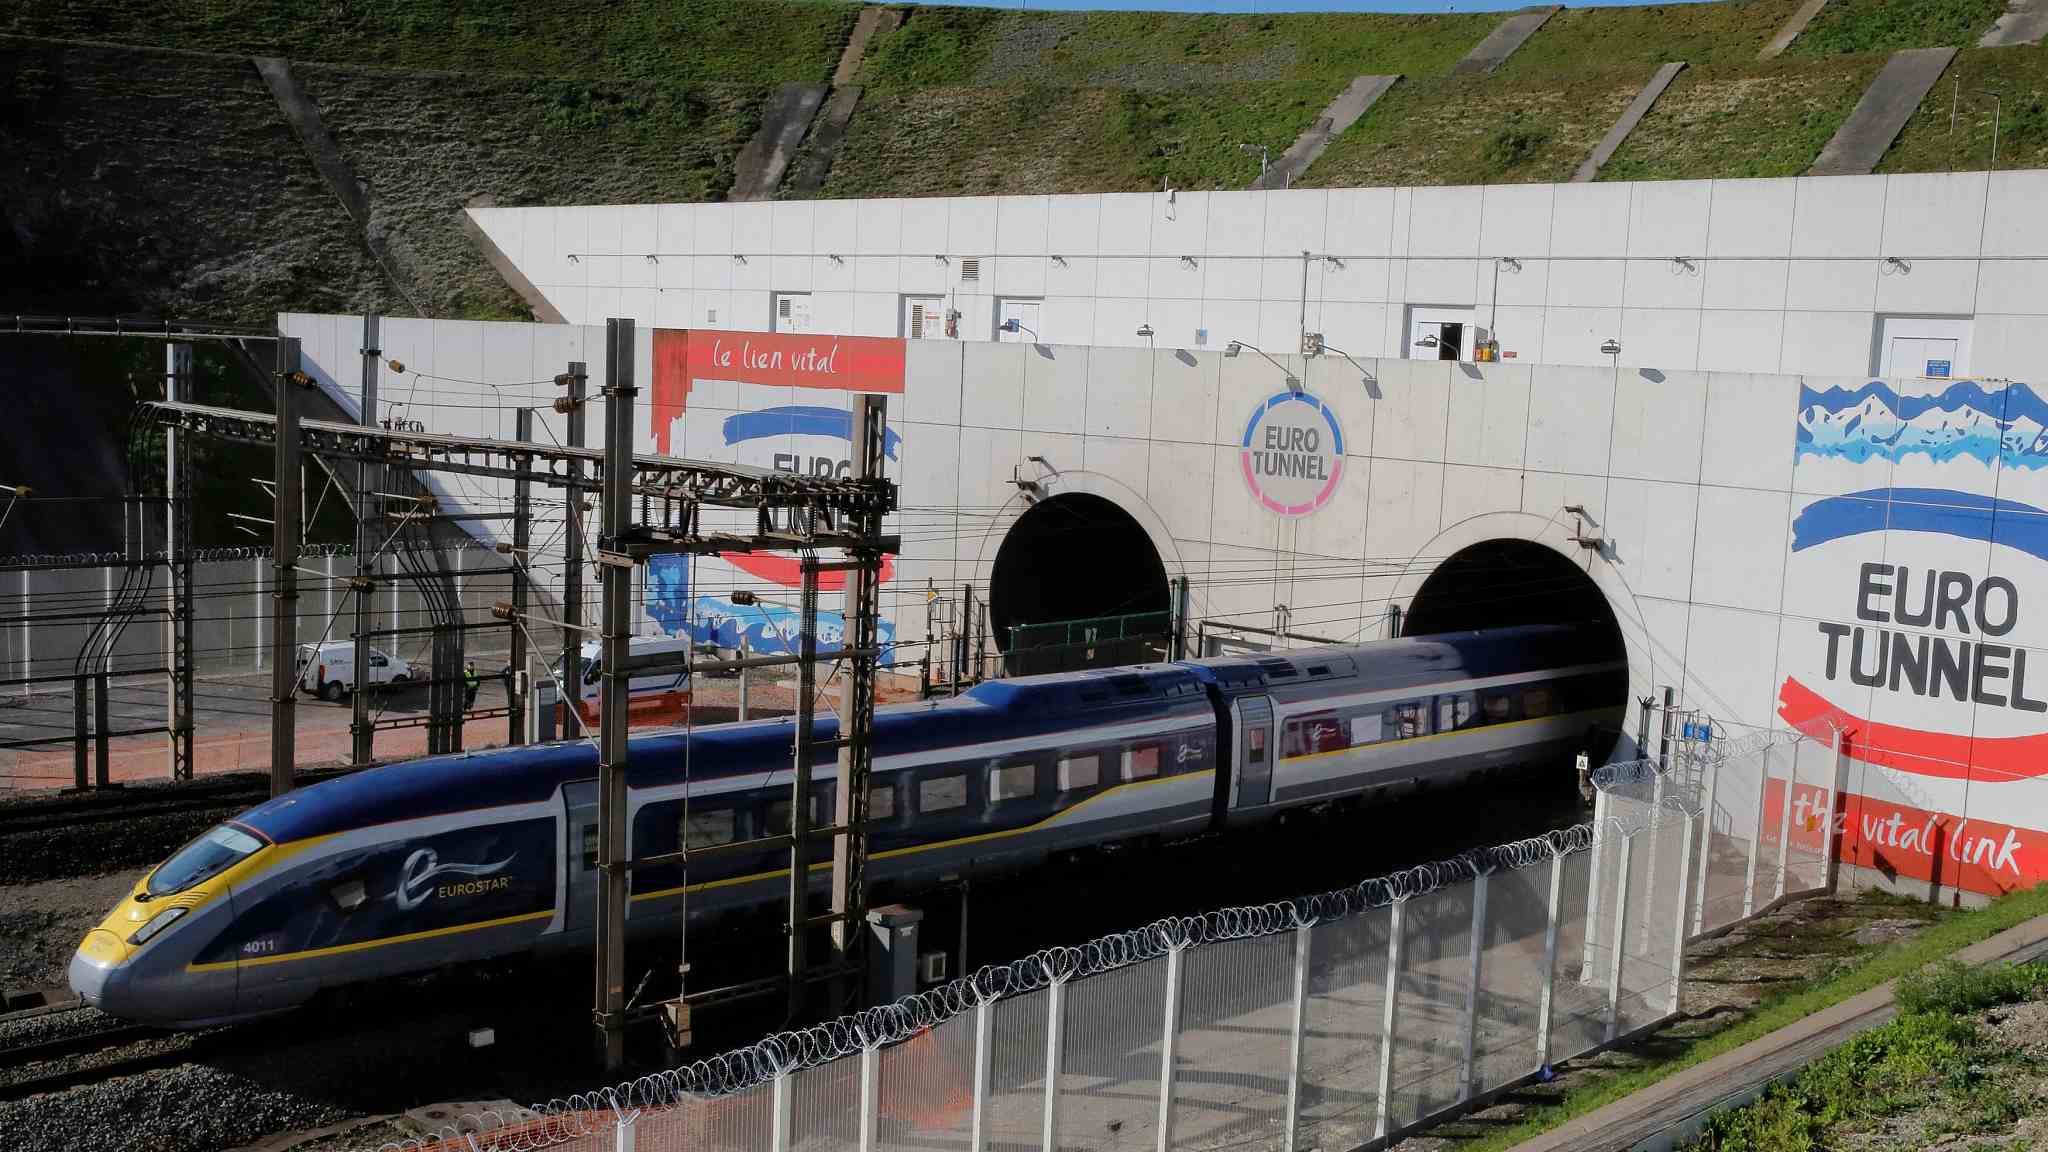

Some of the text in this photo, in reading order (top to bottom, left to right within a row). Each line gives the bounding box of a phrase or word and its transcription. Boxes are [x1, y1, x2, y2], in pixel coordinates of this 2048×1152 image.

[712, 339, 841, 374] le lien vital
[1265, 425, 1320, 453] EURO
[1253, 450, 1329, 481] TUNNEL
[1856, 562, 2019, 637] EURO
[1818, 621, 2048, 713] TUNNEL
[1862, 812, 1940, 855] vital
[1950, 816, 2023, 876] link
[438, 876, 509, 898] EUROSTAR
[242, 940, 273, 952] 4011
